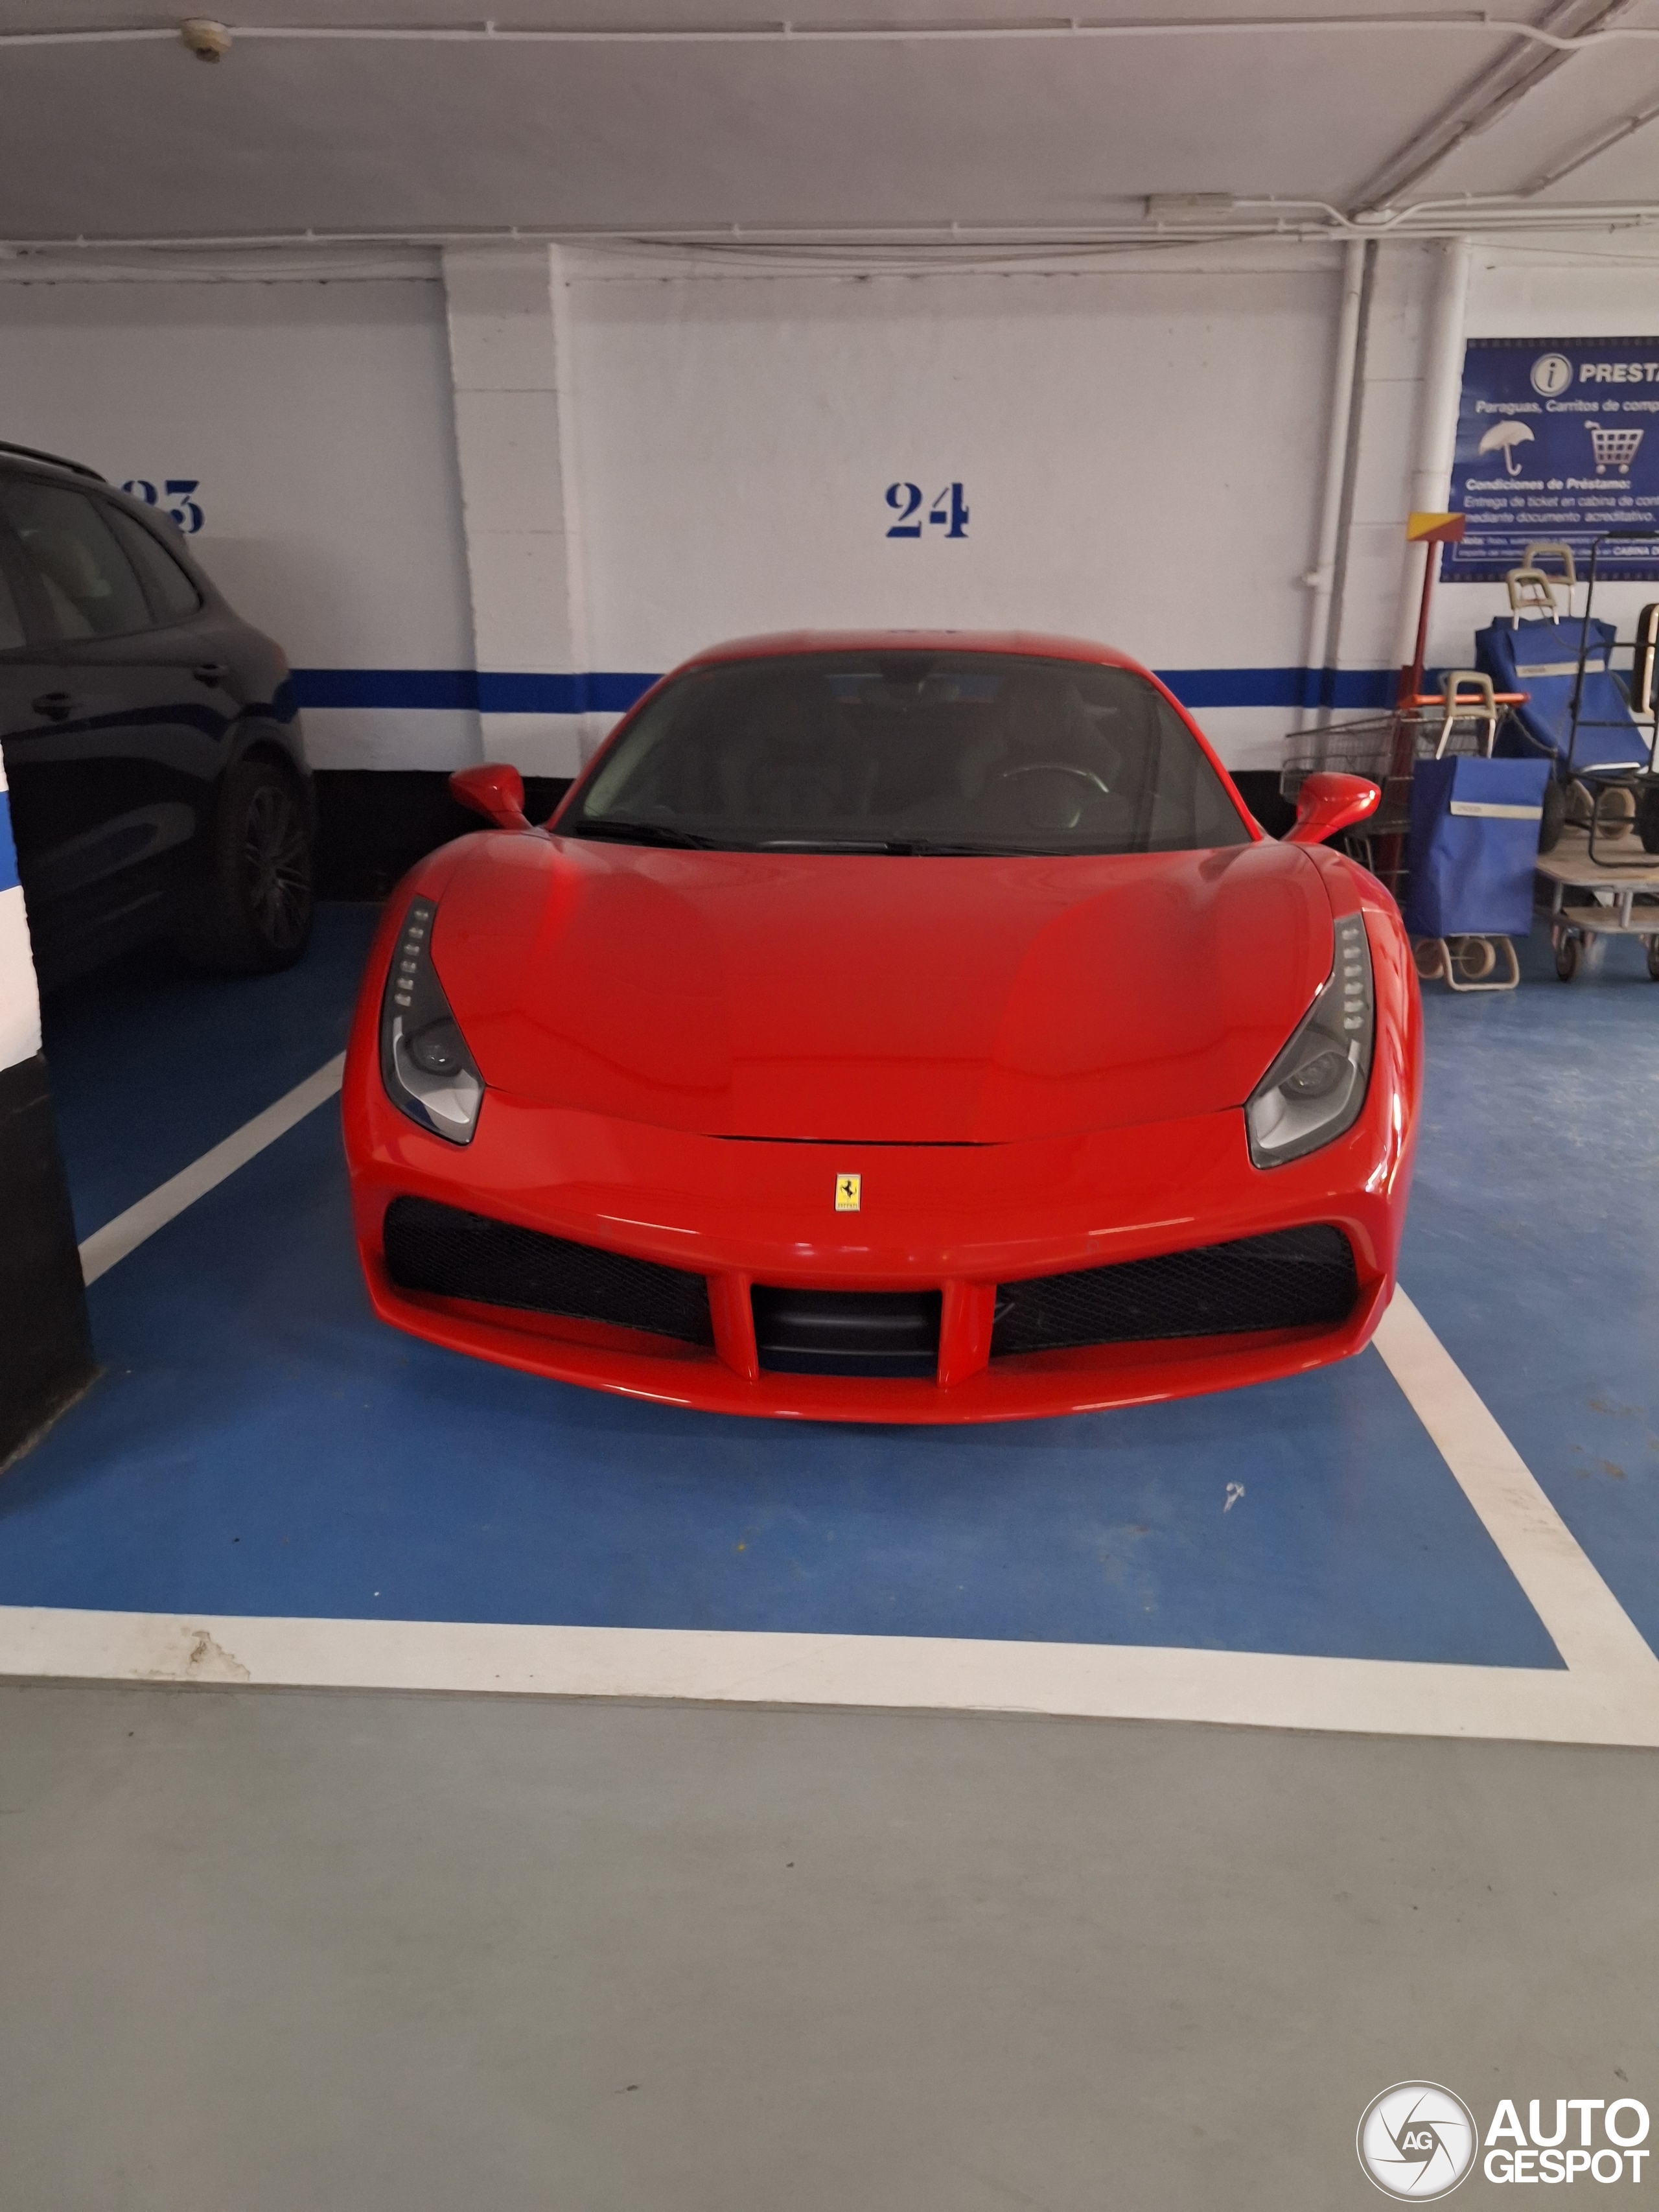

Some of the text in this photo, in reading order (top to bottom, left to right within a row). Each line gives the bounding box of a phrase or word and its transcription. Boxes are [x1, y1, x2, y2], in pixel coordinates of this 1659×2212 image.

[1579, 362, 1659, 382] PREST
[1602, 399, 1620, 412] de
[1466, 478, 1544, 491] Condiciones
[1547, 478, 1564, 490] de
[1509, 496, 1526, 507] de
[1618, 496, 1634, 507] de
[885, 482, 969, 538] 24
